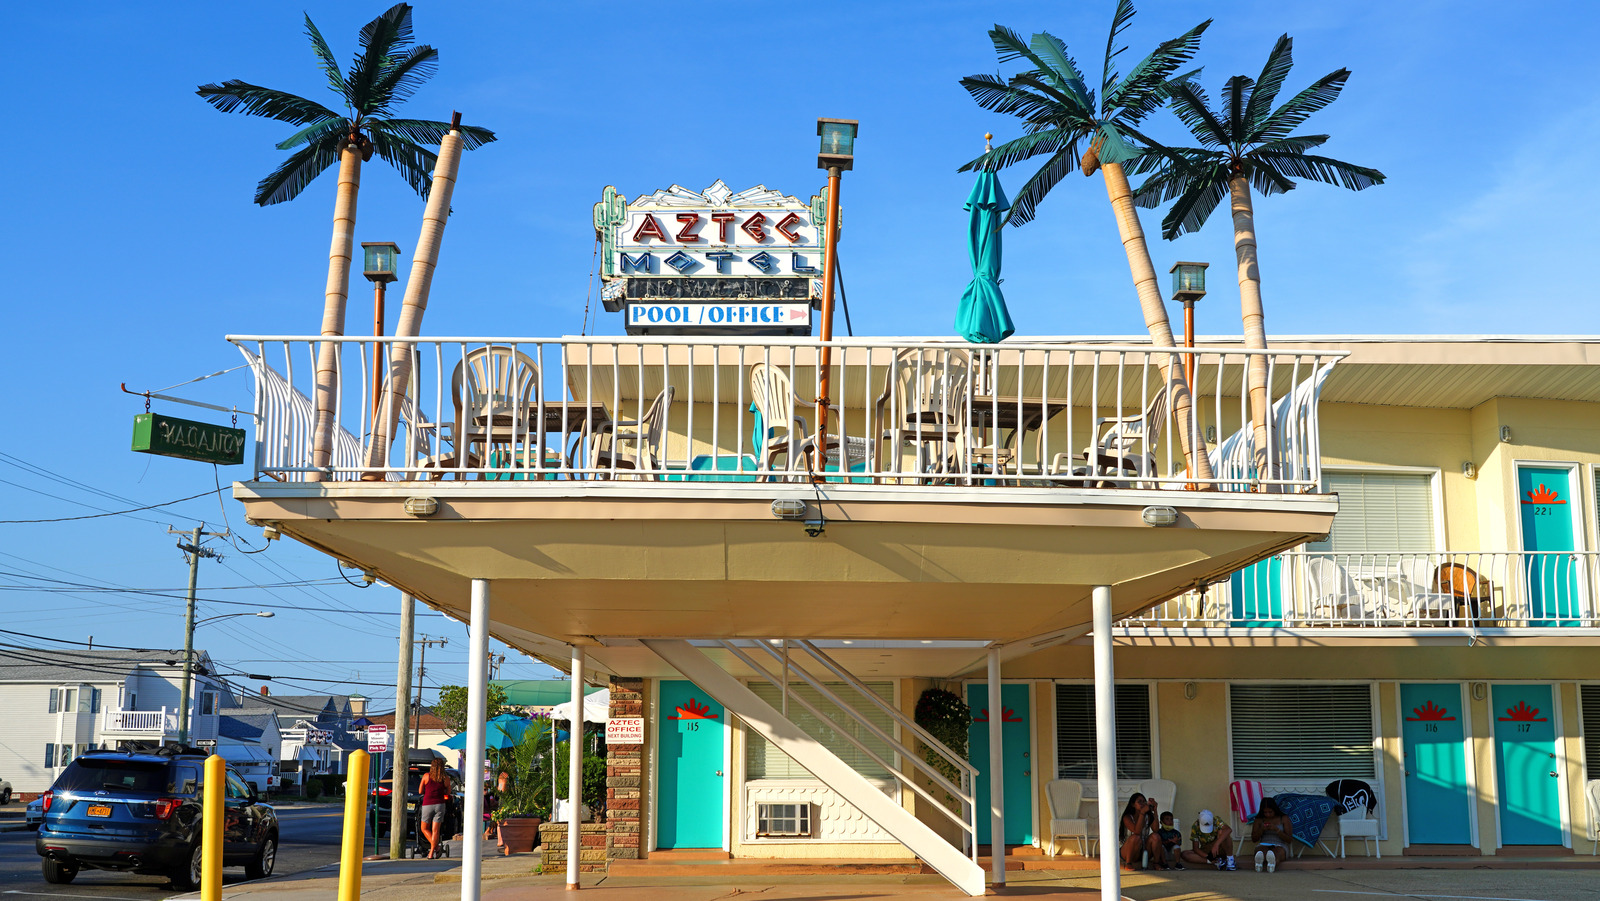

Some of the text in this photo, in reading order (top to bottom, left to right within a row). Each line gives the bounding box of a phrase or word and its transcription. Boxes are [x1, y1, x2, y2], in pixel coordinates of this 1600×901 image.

[632, 211, 801, 243] AZTEC
[620, 250, 816, 274] MOTEL
[645, 280, 790, 298] NO VACANCY
[1534, 506, 1552, 516] 221
[687, 722, 699, 732] 115
[1425, 723, 1438, 733] 116
[1518, 723, 1531, 733] 117
